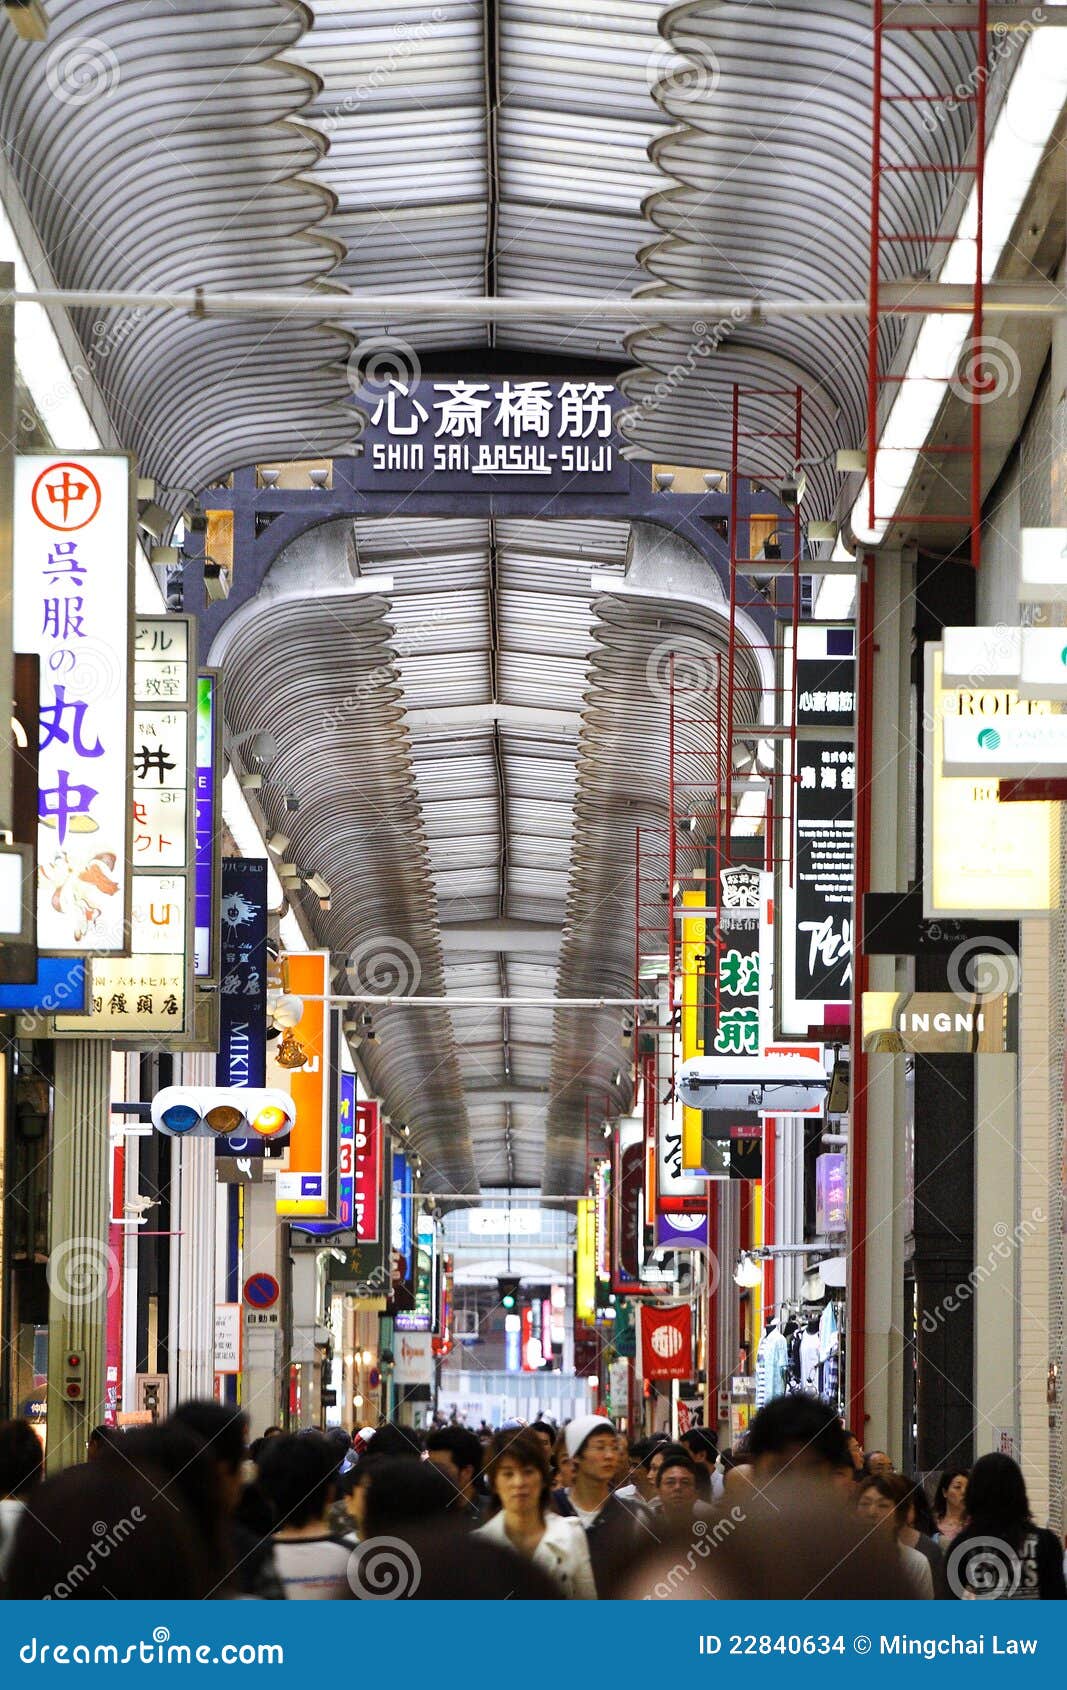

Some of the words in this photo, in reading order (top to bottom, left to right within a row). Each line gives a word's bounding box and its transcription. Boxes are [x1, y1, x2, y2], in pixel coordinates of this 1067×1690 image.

[370, 380, 615, 439] 心斎橋筋
[373, 444, 424, 470] SHIN
[433, 444, 469, 471] SAI
[38, 541, 105, 847] 呉服の丸中
[799, 691, 856, 711] 心斎橋筋
[901, 1013, 985, 1032] INGNI
